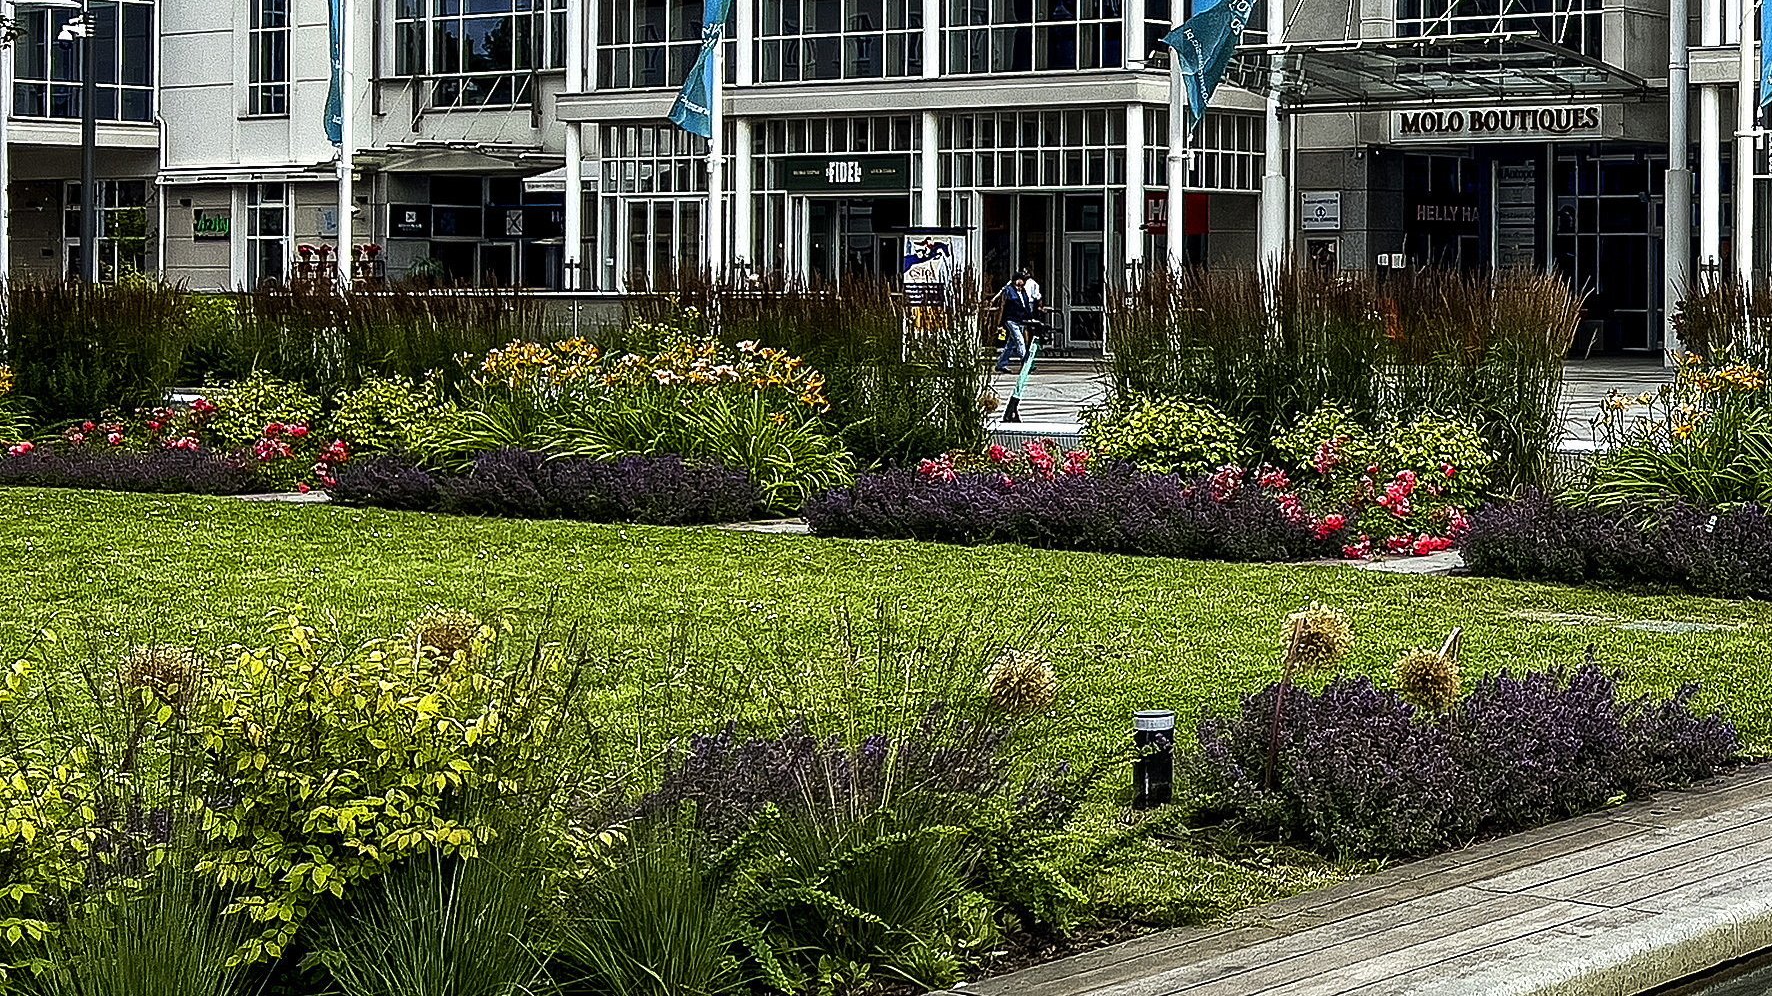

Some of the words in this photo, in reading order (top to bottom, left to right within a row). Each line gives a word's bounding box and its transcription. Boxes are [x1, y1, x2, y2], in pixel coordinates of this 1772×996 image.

[1399, 110, 1465, 134] MOLO
[1467, 107, 1600, 134] BOUTIQUES
[1416, 204, 1458, 221] HELLY
